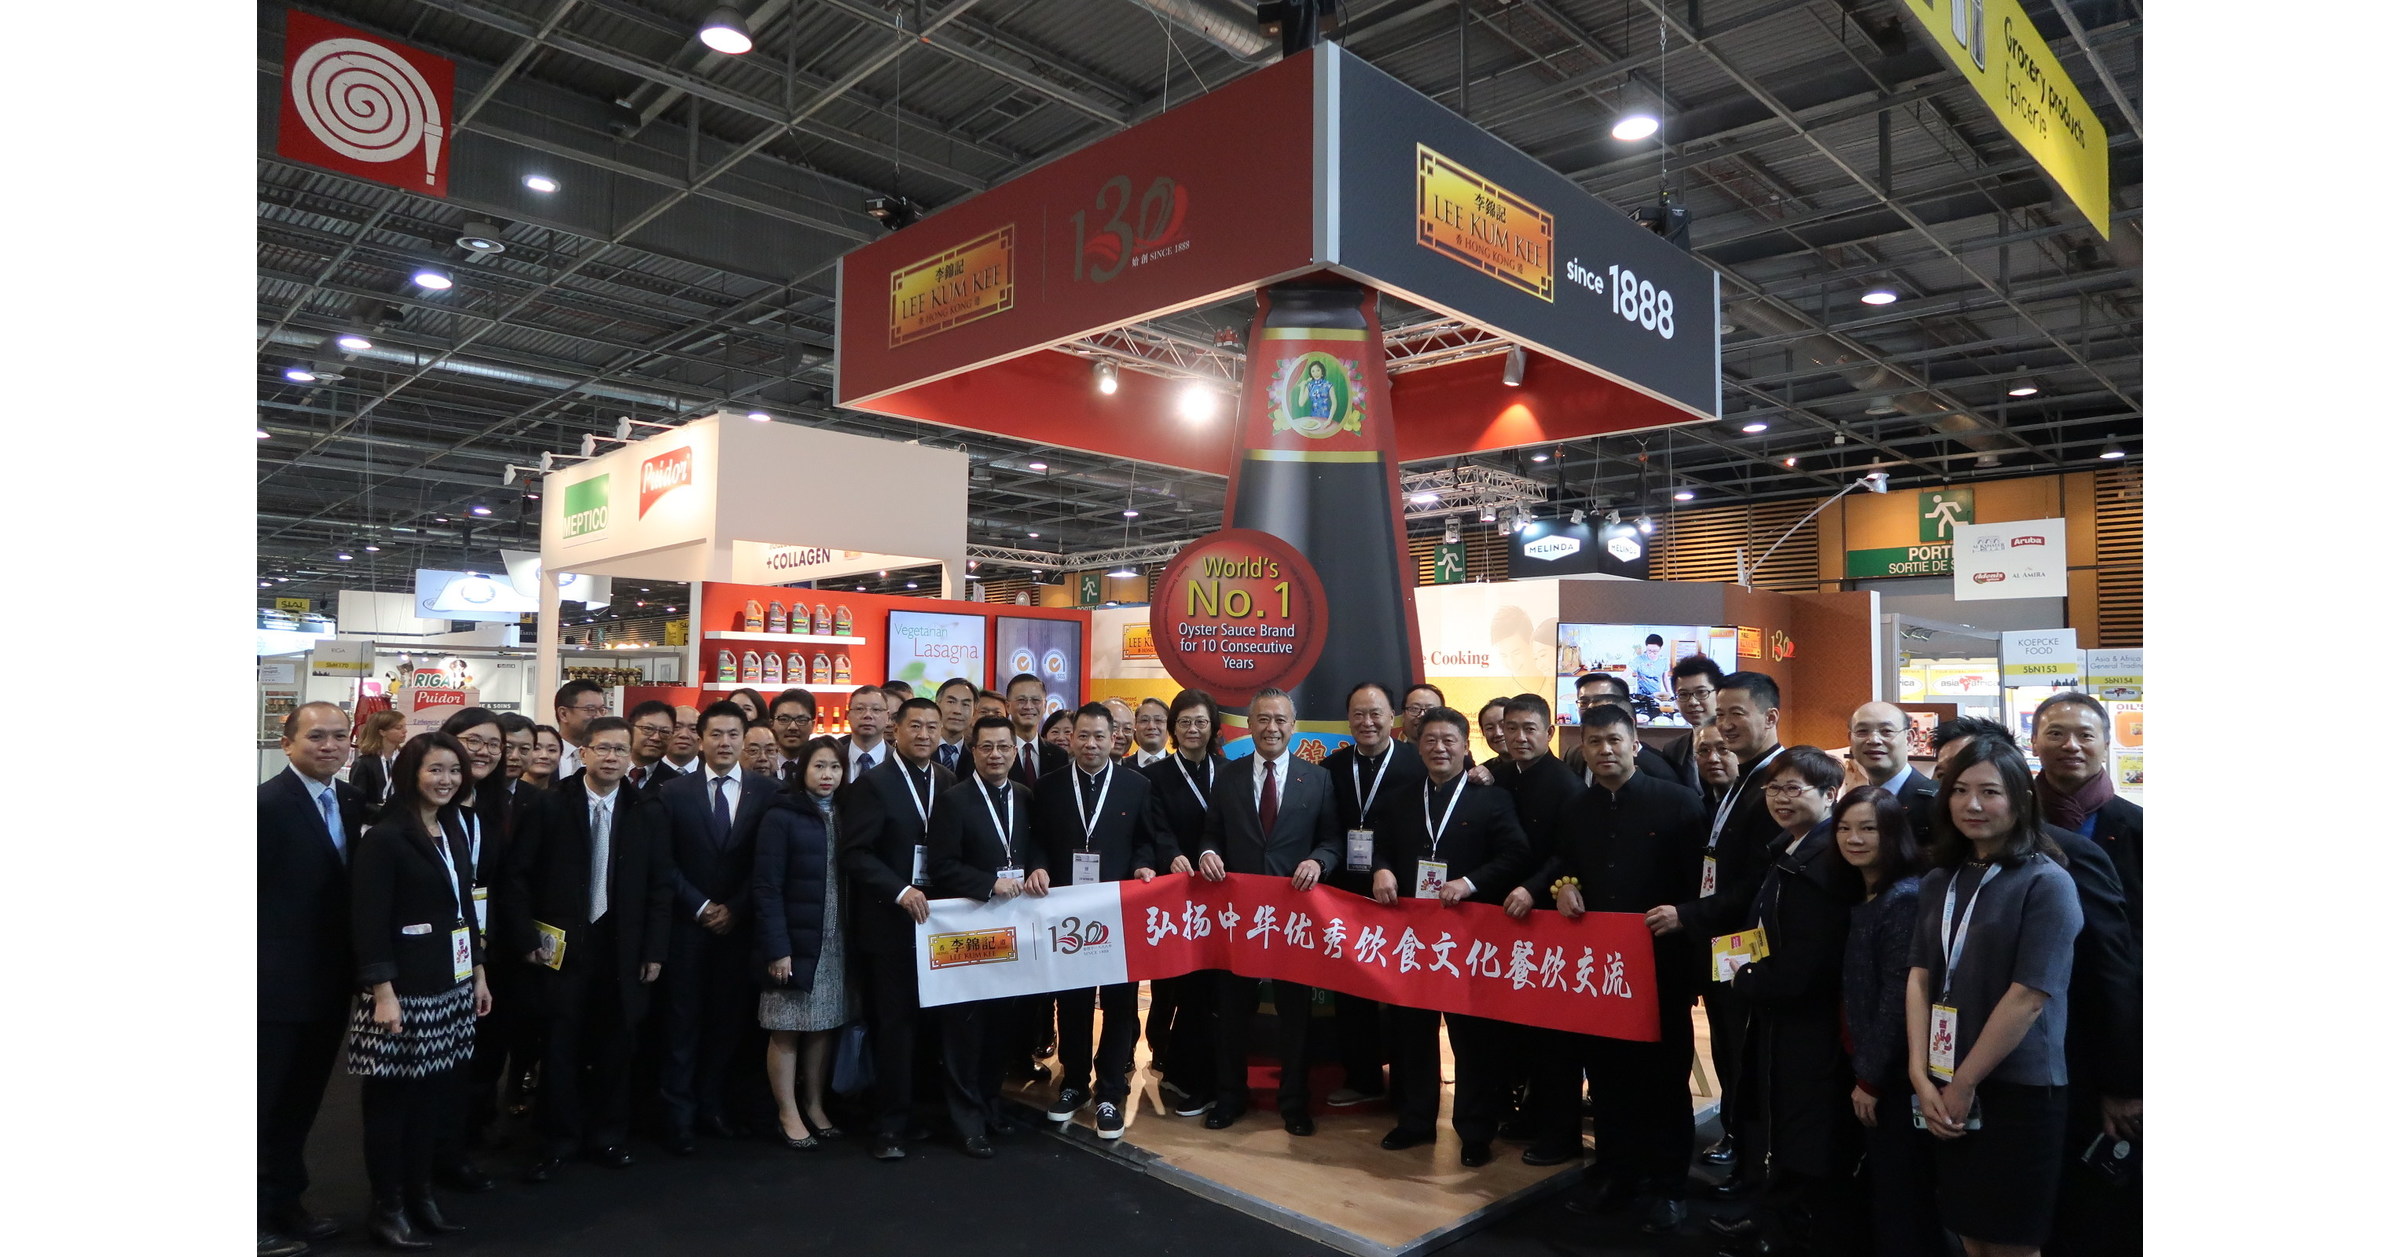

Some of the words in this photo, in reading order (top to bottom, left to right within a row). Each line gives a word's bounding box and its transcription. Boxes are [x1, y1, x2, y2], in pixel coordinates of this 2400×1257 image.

[2004, 16, 2046, 104] Grocery
[2049, 84, 2085, 149] products
[1474, 193, 1506, 224] 李錦記
[1070, 175, 1184, 283] 130
[1433, 195, 1464, 231] LEE
[1470, 214, 1510, 253] KUM
[1514, 235, 1542, 269] KEE
[1150, 247, 1173, 260] SINCE
[1175, 240, 1190, 253] 1888
[1464, 238, 1491, 259] HONG
[1492, 250, 1516, 270] KONG
[935, 258, 964, 283] 李錦記
[902, 292, 926, 319] LEE
[931, 276, 967, 309] KUM
[972, 263, 1001, 294] KEE
[1566, 257, 1604, 295] since
[1609, 264, 1676, 340] 1888
[926, 309, 949, 323] HONG
[950, 300, 972, 315] KONG
[642, 457, 688, 494] Puidor
[563, 506, 607, 537] MEPTICO
[1529, 544, 1574, 554] MELINDA
[2014, 537, 2042, 546] Aruba
[1909, 545, 1955, 561] PORT
[1202, 556, 1280, 578] World's
[1888, 561, 1929, 574] SORTIE
[1932, 560, 1948, 571] DE
[1187, 579, 1290, 619] No.1
[1178, 622, 1218, 638] Oyster
[1221, 623, 1256, 637] Sauce
[1260, 624, 1295, 637] Brand
[914, 638, 979, 664] Lasagna
[1128, 638, 1142, 648] LEE
[1180, 640, 1197, 652] for
[1202, 640, 1216, 652] 10
[1220, 640, 1293, 654] Consecutive
[1771, 630, 1793, 662] 130
[2018, 638, 2060, 647] KOEPCKE
[2026, 647, 2053, 655] FOOD
[1222, 656, 1254, 669] Years
[1431, 650, 1490, 668] Cooking
[2090, 662, 2118, 670] General
[415, 674, 450, 687] RIGA
[1941, 679, 1960, 687] asia
[417, 691, 461, 703] Puidor
[950, 936, 996, 953] 李錦記
[1048, 916, 1107, 954] 130
[950, 953, 961, 961] LEE
[964, 952, 983, 960] KUM
[983, 950, 996, 958] KEE
[1146, 900, 1632, 999] 弘扬中华优秀饮食文化餐饮交流
